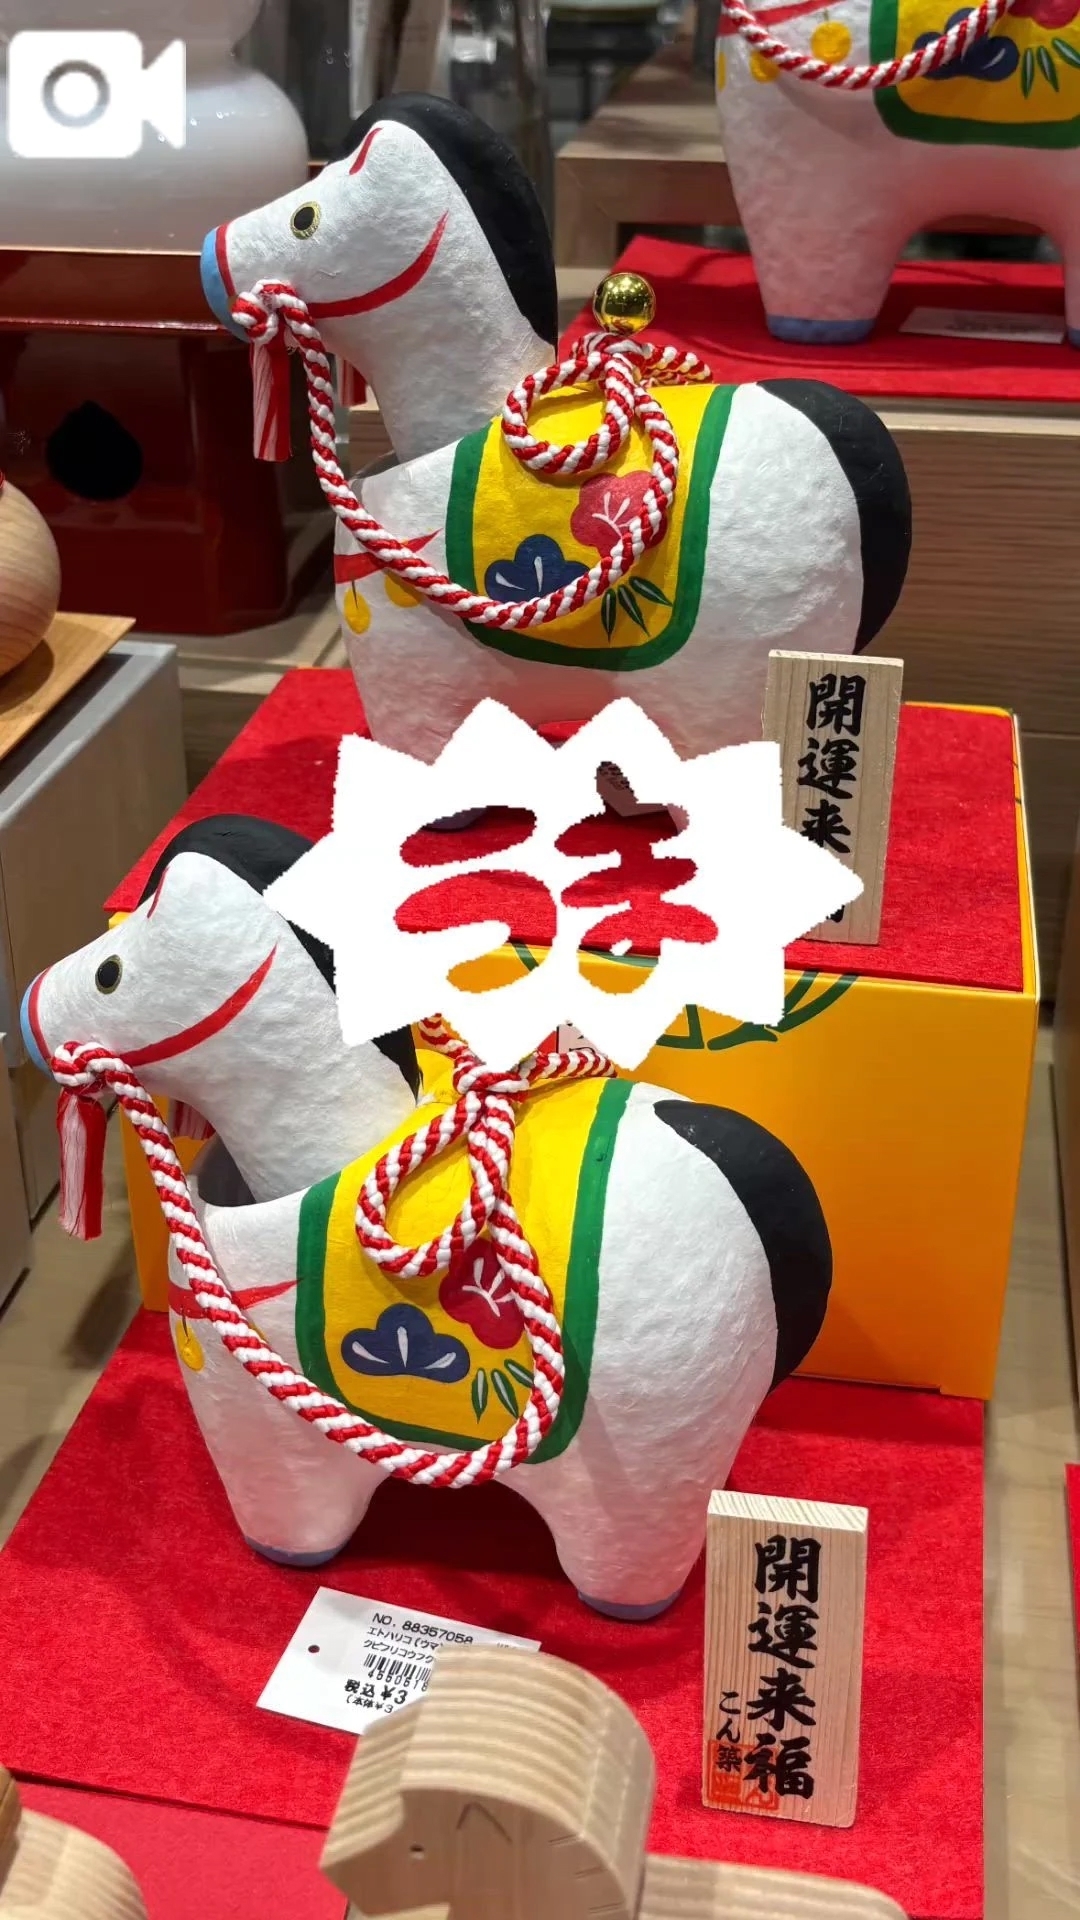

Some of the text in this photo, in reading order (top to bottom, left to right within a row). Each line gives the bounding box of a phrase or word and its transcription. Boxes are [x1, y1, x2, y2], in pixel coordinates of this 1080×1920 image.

[797, 673, 866, 922] 開運来
[372, 1613, 474, 1645] NO. 88357058
[744, 1534, 822, 1800] 開運来福
